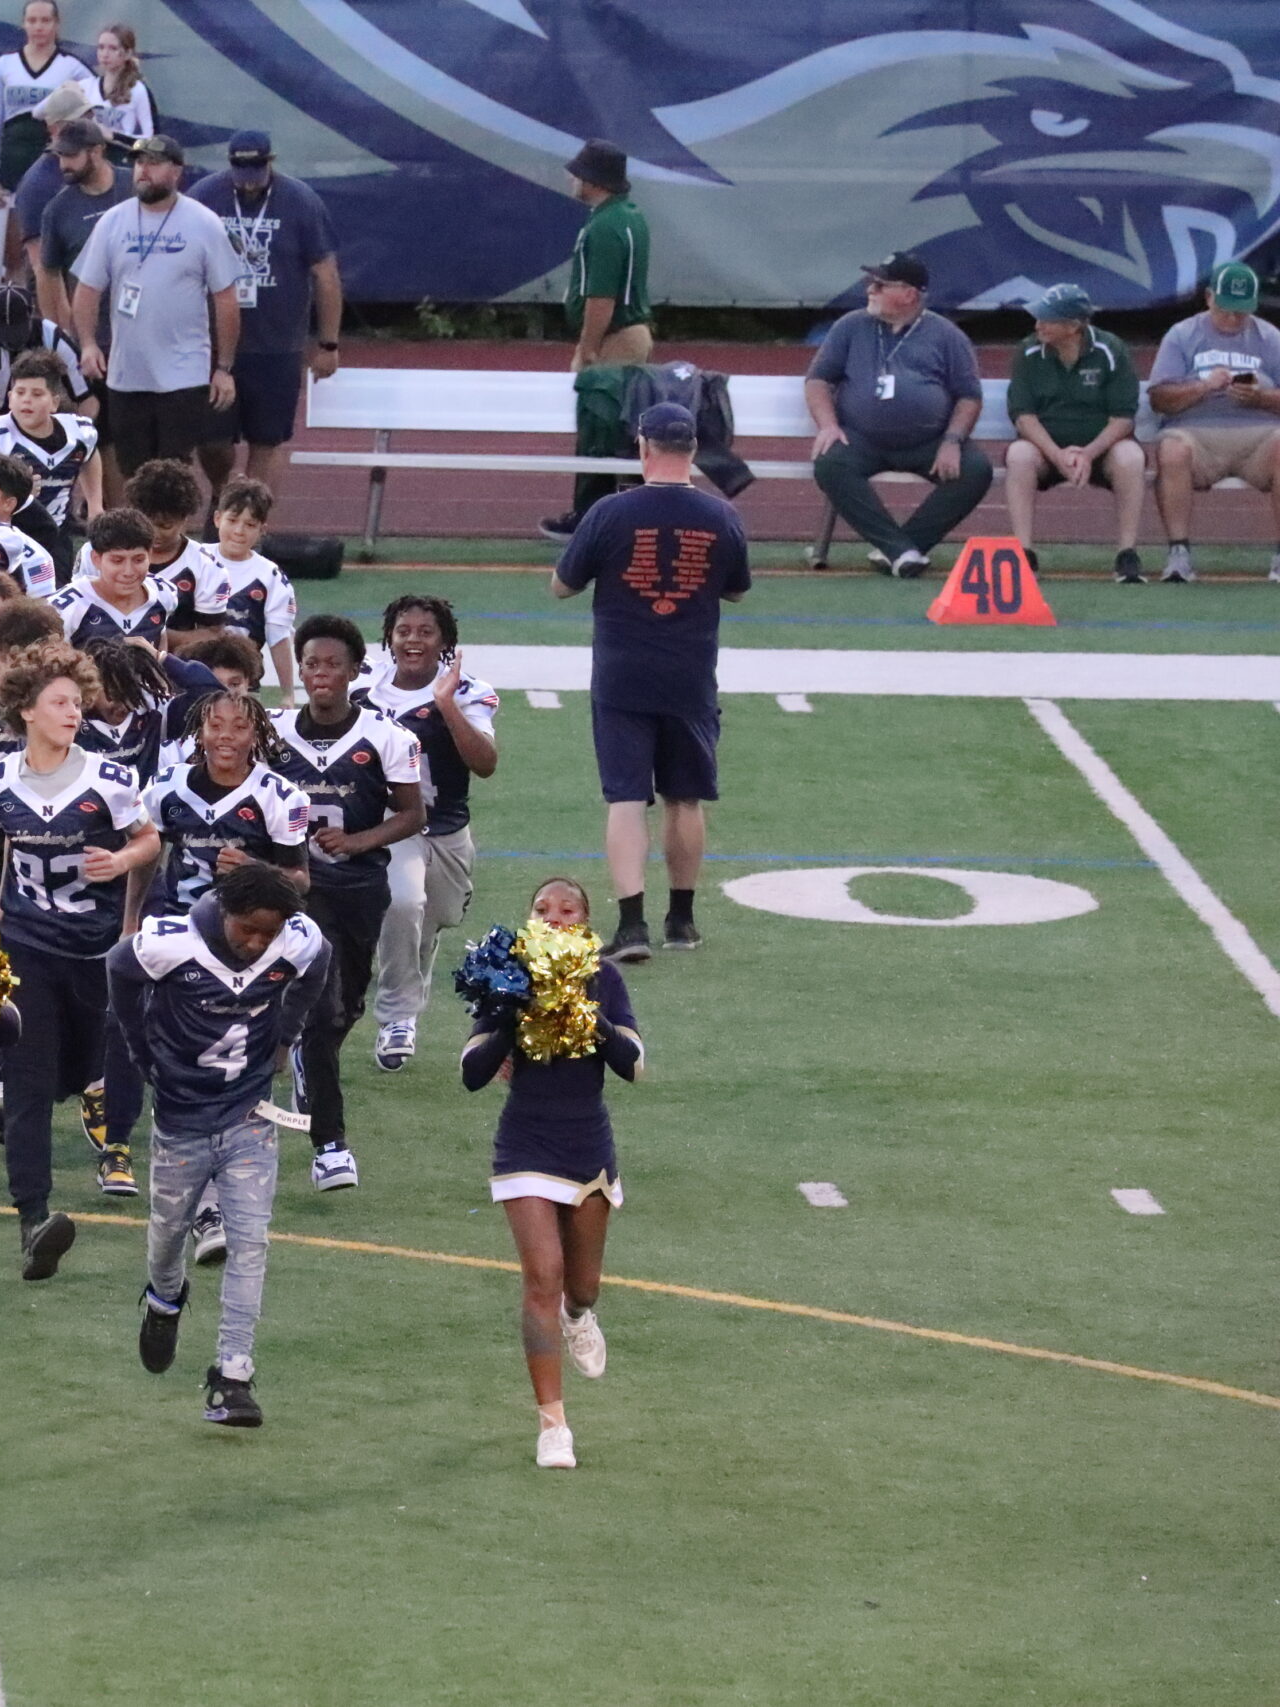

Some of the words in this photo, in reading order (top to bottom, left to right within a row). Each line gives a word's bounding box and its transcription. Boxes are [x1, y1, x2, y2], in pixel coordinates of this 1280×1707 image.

[961, 548, 1022, 615] 40
[123, 618, 132, 630] N
[316, 756, 327, 767] N
[42, 805, 54, 817] N
[205, 808, 216, 821] N
[11, 848, 97, 914] 82
[232, 976, 245, 988] N
[197, 1023, 250, 1083] 4
[276, 1112, 308, 1127] PURPLE
